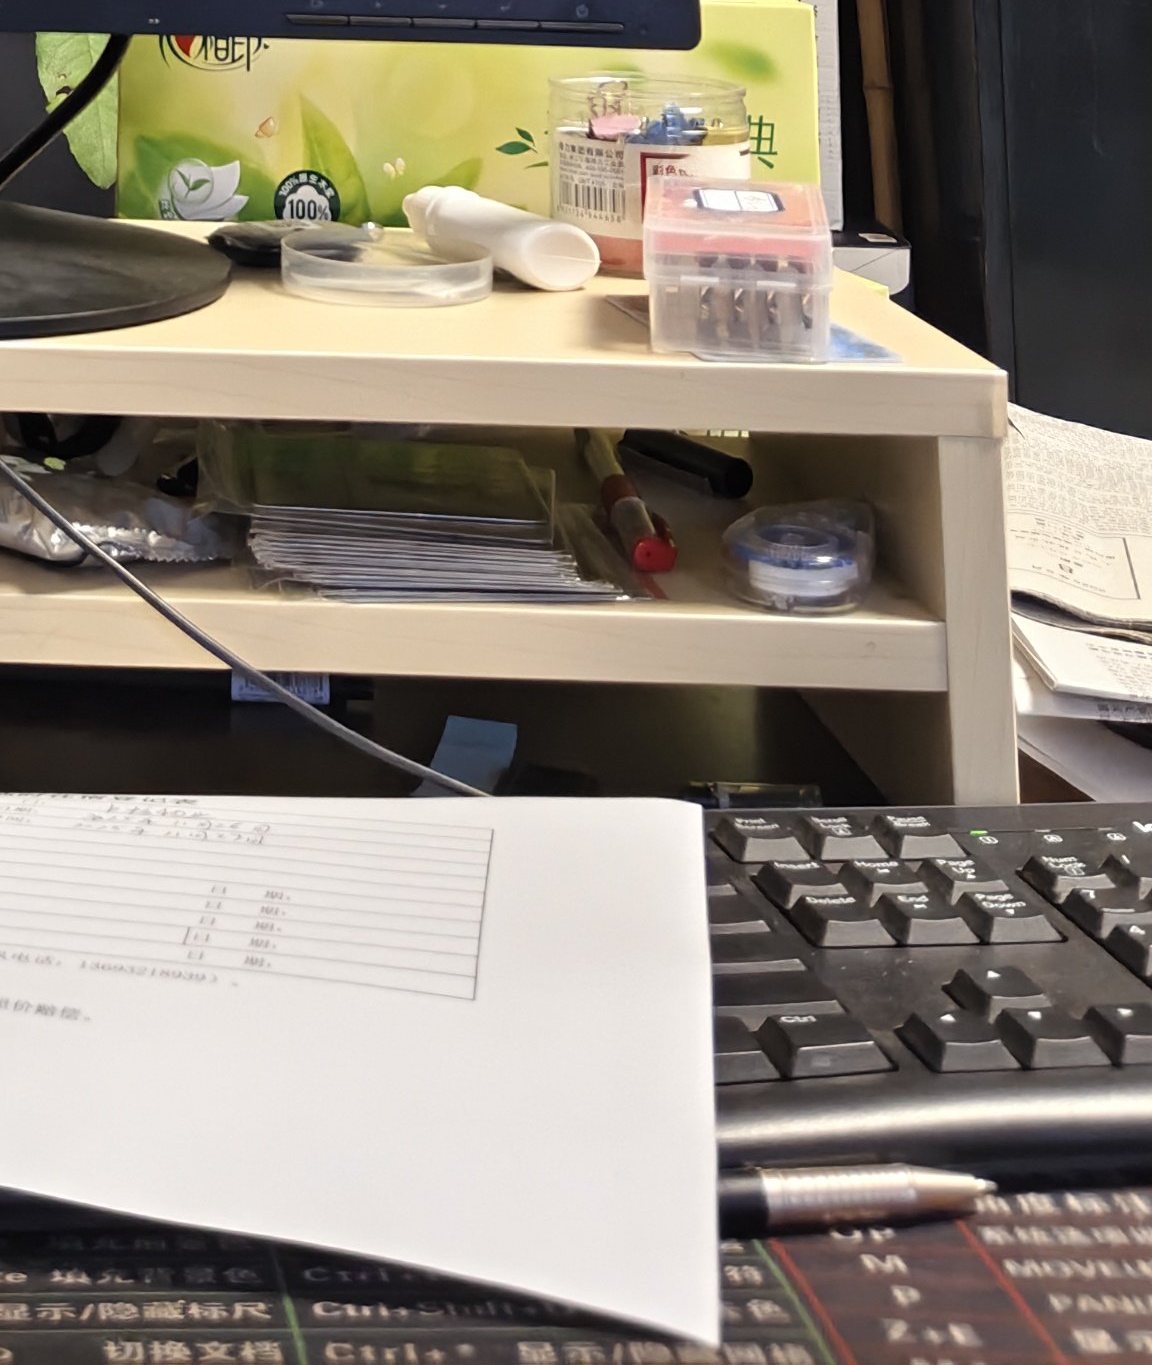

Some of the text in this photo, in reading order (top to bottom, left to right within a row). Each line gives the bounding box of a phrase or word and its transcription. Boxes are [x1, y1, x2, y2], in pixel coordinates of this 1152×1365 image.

[773, 861, 821, 869] Insert
[854, 860, 900, 868] Home
[936, 859, 975, 867] Page
[805, 896, 856, 904] Delete
[974, 893, 1014, 901] Page
[779, 1014, 817, 1024] Ctrl
[859, 1254, 909, 1273] M
[890, 1284, 922, 1307] P
[102, 1340, 284, 1364] 切换文档
